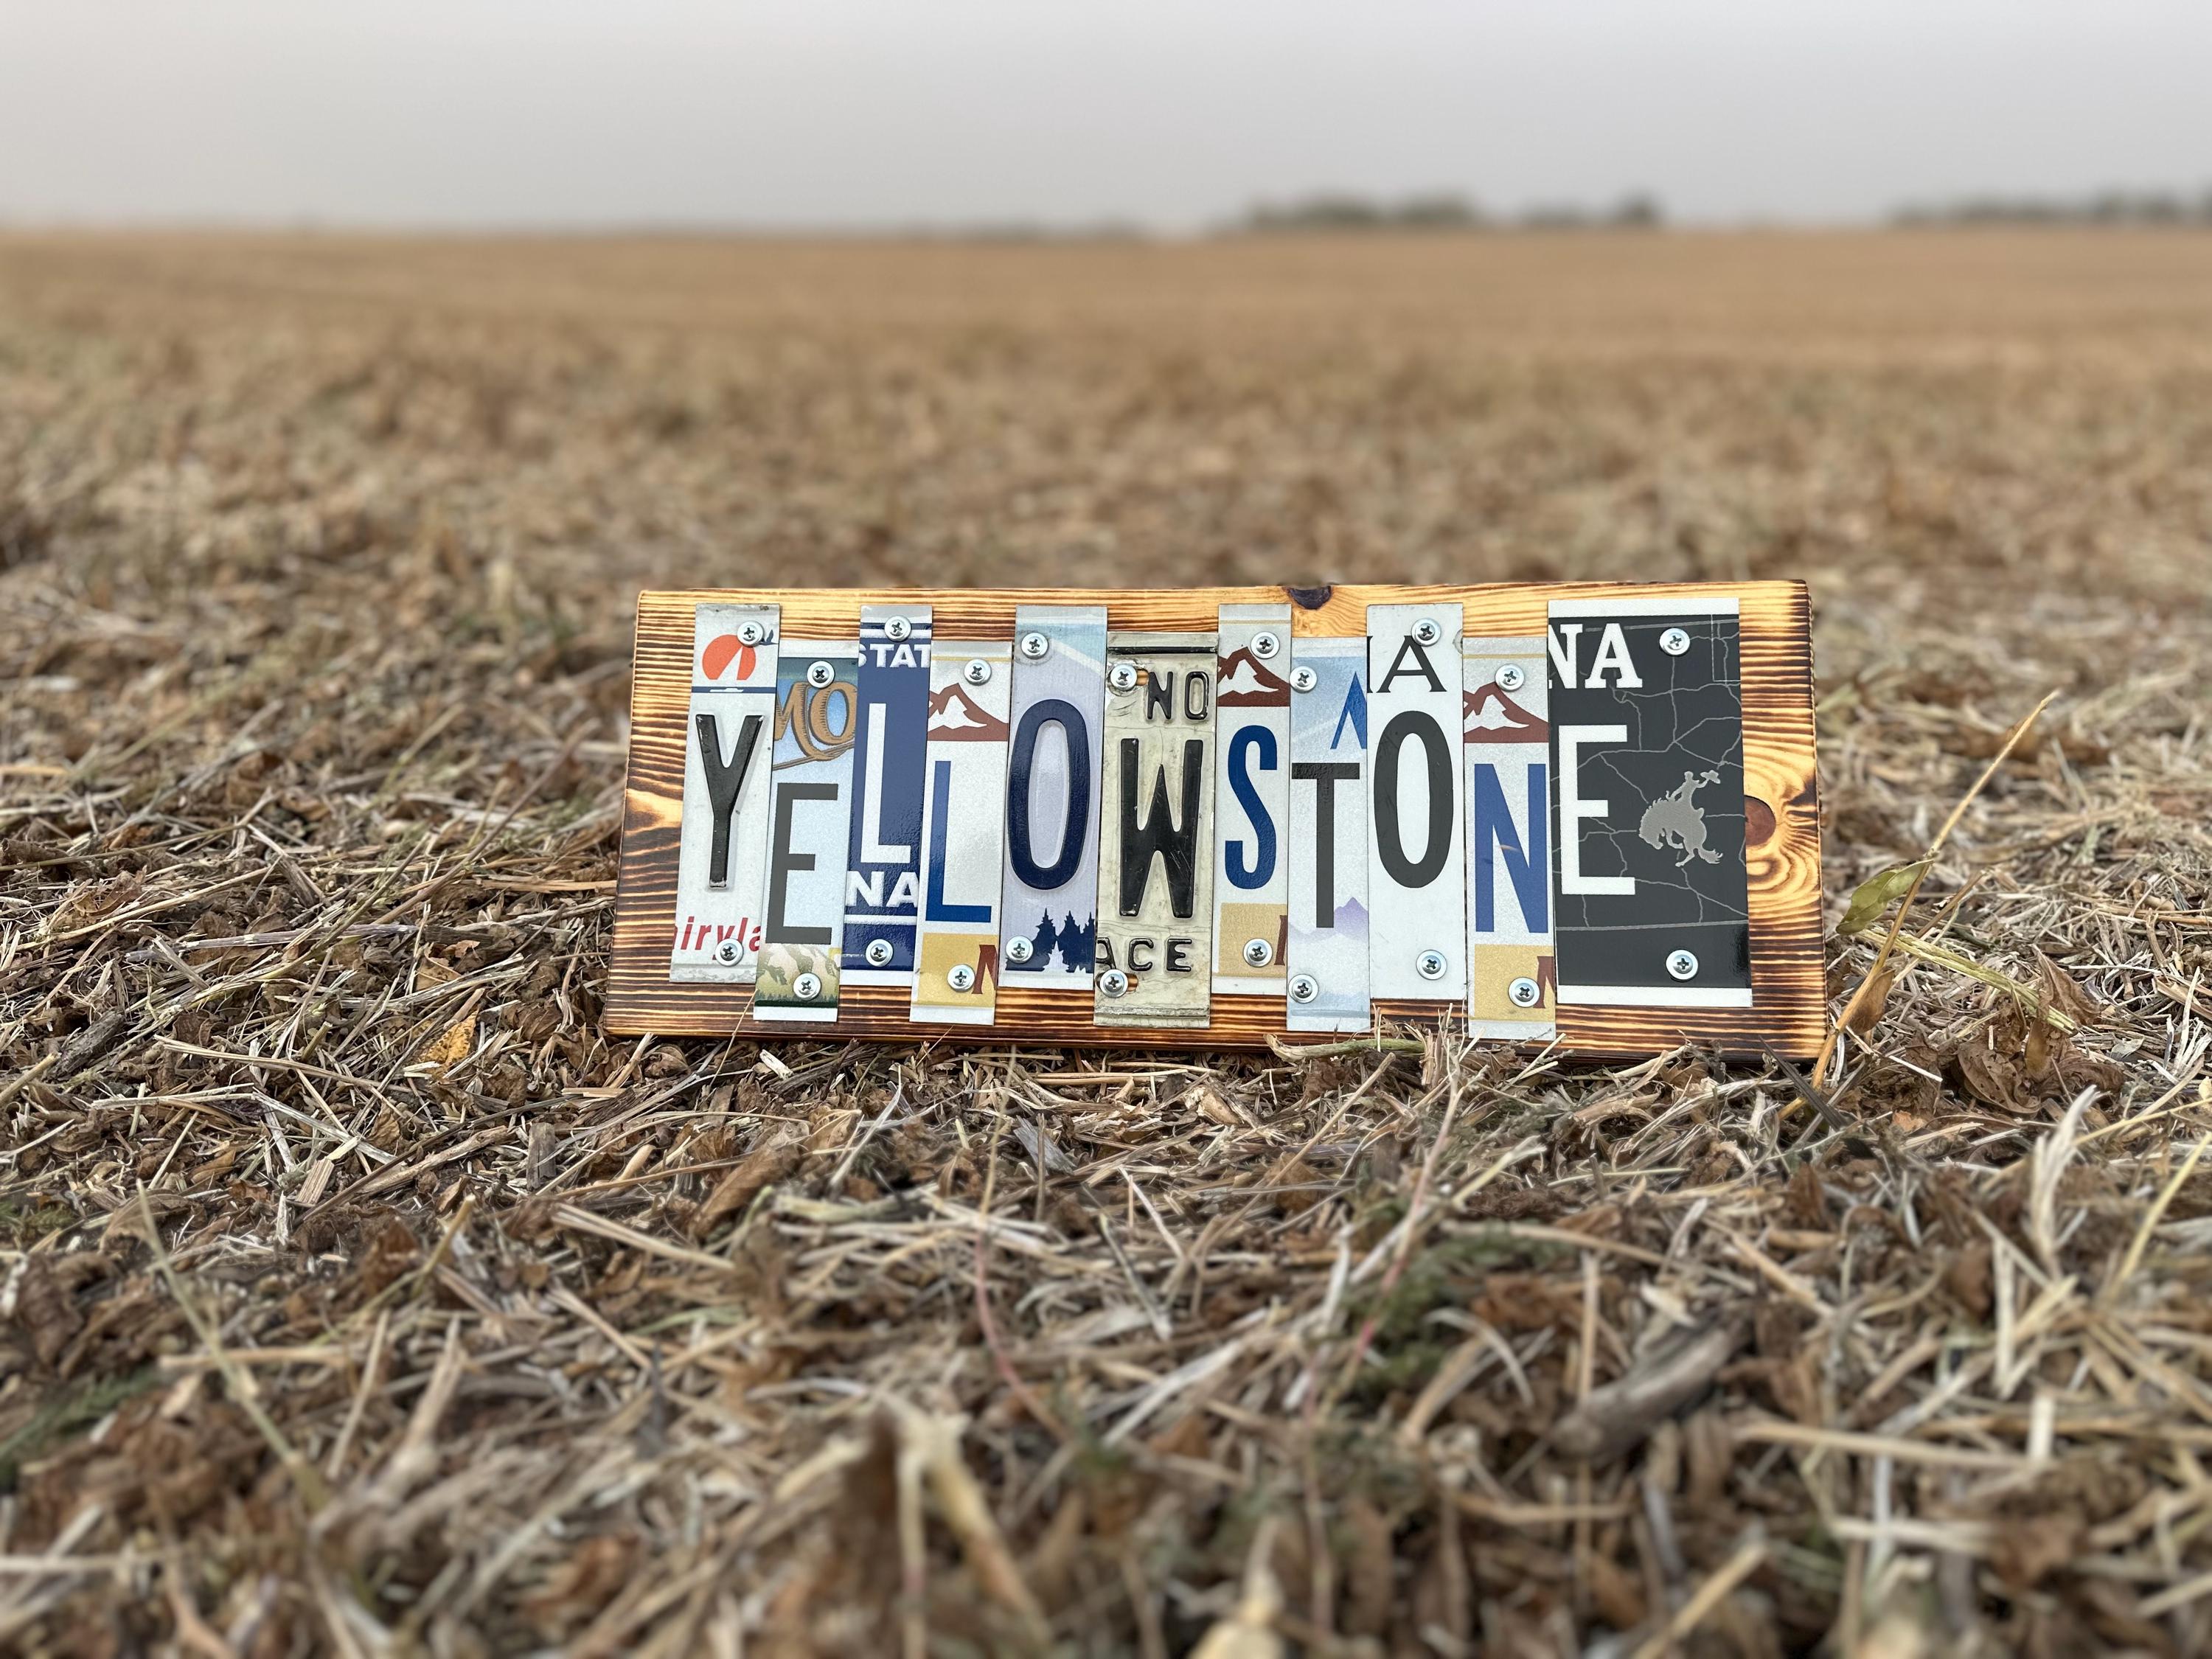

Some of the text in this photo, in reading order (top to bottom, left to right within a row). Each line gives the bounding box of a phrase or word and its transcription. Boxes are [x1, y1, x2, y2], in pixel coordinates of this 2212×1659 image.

[1548, 623, 1643, 689] NA
[1147, 670, 1209, 720] NO
[695, 698, 1635, 945] YELLOWSTONE
[845, 870, 919, 908] NA
[673, 916, 761, 961] iryla
